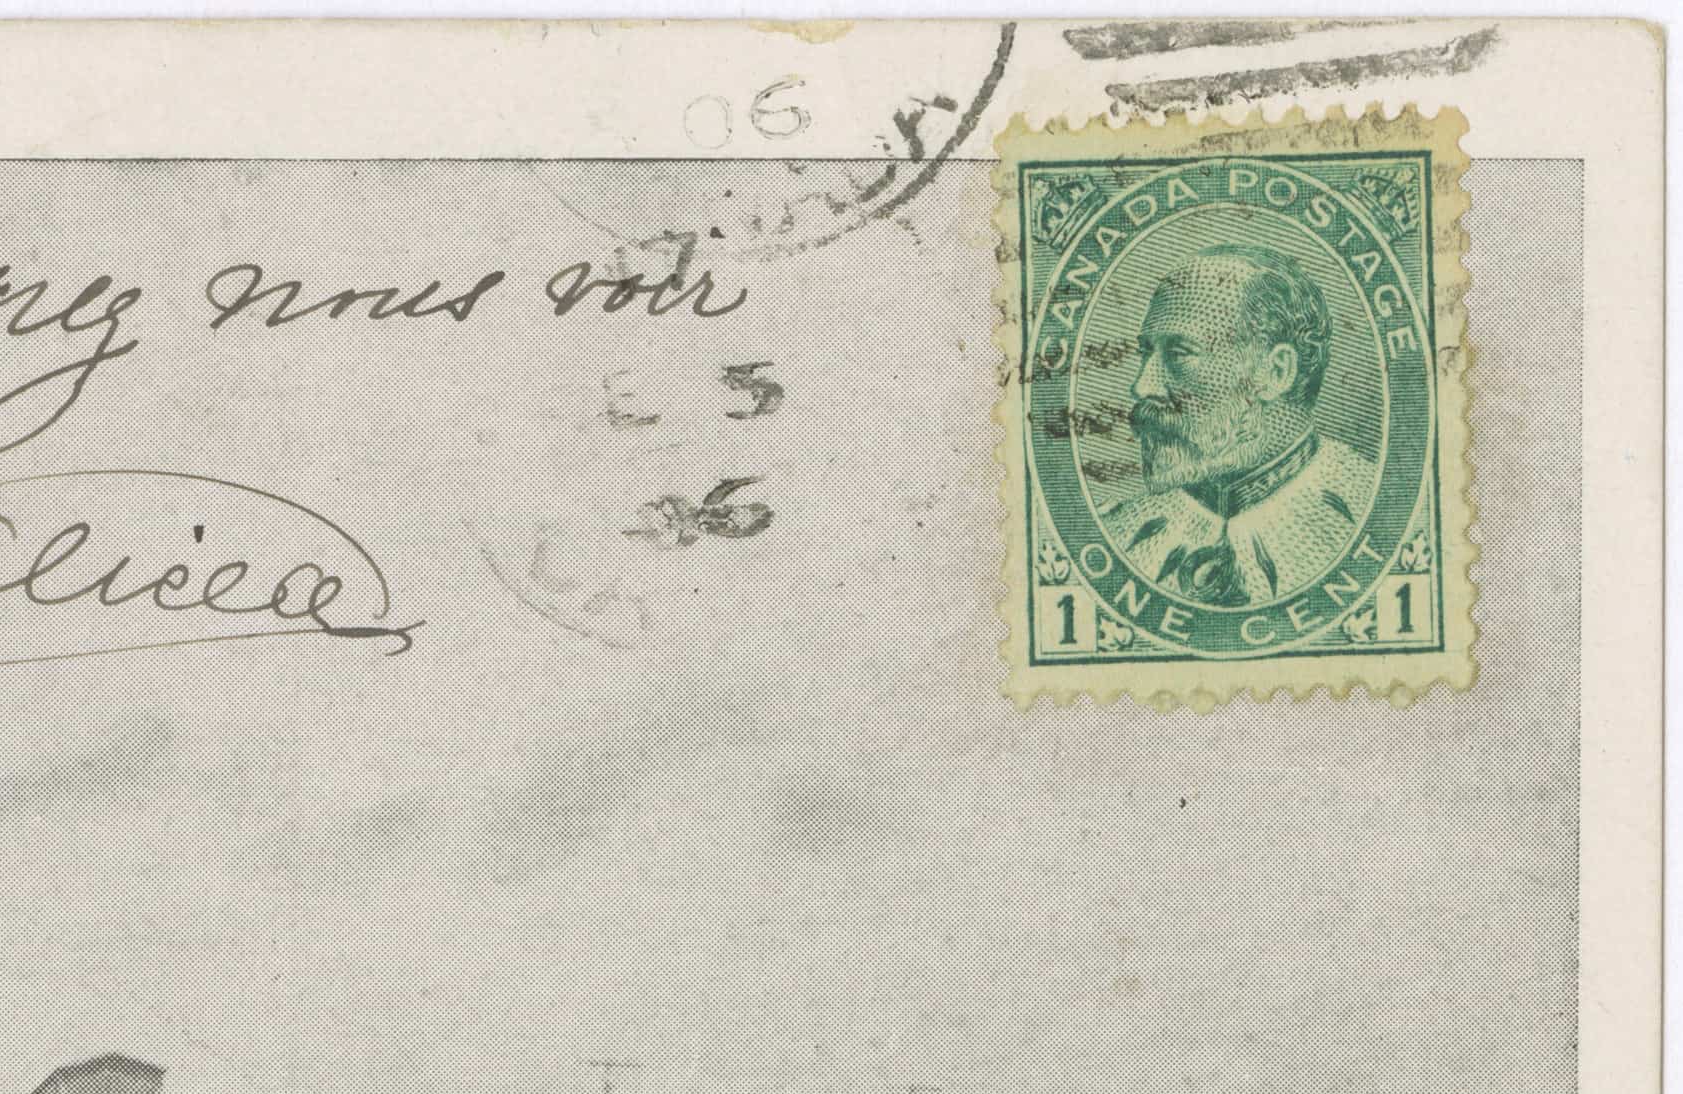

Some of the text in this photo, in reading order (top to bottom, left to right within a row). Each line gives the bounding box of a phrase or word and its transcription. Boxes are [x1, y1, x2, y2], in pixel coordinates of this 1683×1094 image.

[206, 263, 506, 330] nous
[545, 261, 748, 318] voir
[1043, 166, 1419, 372] CANADA POSTAGE
[1056, 592, 1079, 647] 1
[1078, 540, 1388, 645] ONE CENT
[1393, 581, 1416, 635] 1
